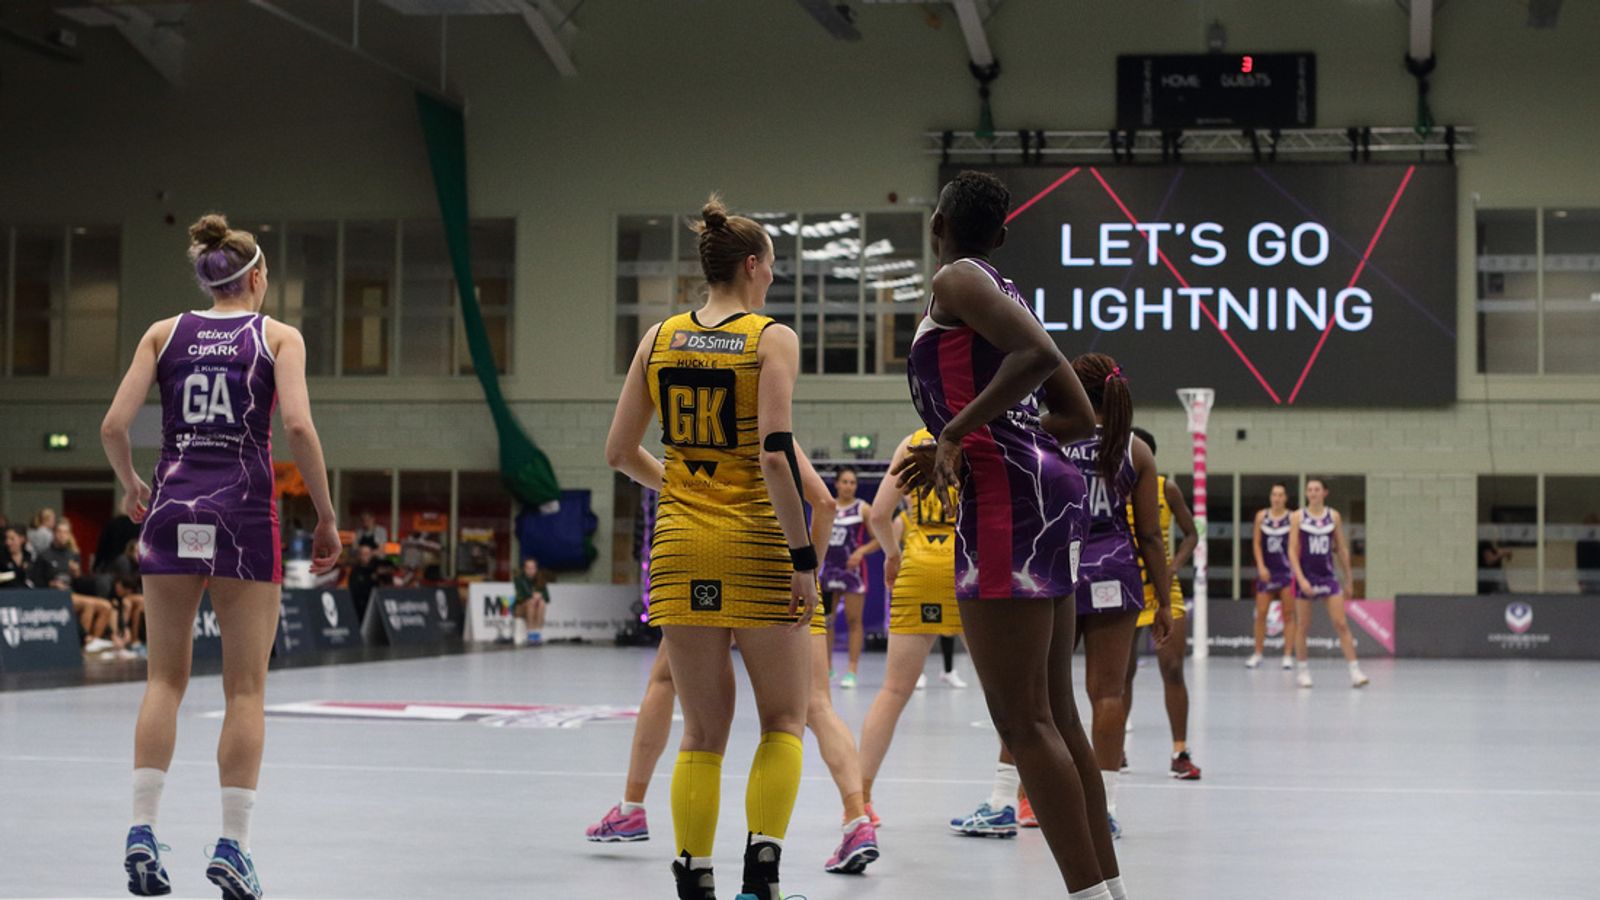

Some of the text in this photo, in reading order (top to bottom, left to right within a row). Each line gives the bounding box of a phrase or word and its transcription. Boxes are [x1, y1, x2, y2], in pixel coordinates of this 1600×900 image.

[1241, 55, 1253, 73] 3
[1161, 74, 1201, 88] HOME
[1060, 221, 1330, 267] LET'S GO
[1035, 287, 1374, 332] LIGHTNING
[187, 344, 239, 356] CLARK
[688, 335, 744, 351] DS Smith
[676, 359, 719, 369] HUCKLE
[182, 372, 236, 425] GA
[668, 384, 728, 447] GK
